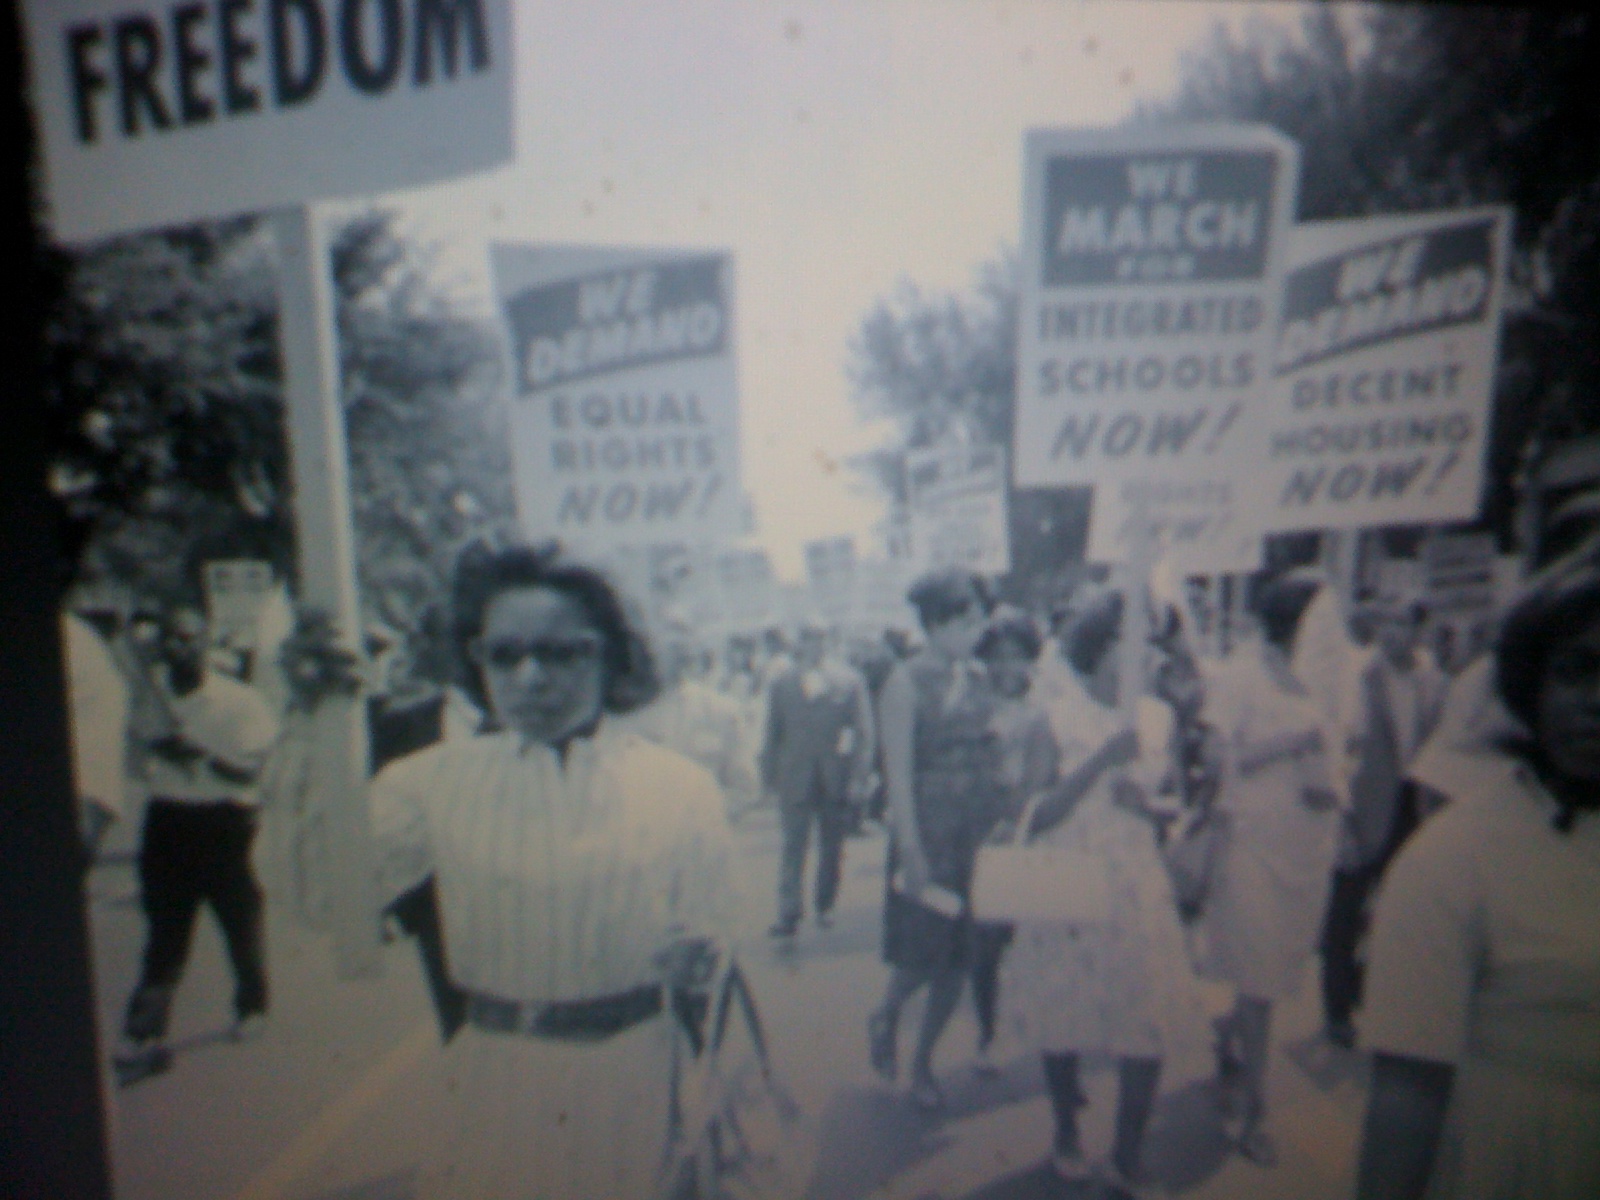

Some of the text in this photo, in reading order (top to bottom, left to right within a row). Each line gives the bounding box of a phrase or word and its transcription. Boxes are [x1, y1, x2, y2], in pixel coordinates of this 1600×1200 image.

[65, 0, 490, 146] FREEDOM
[1126, 158, 1197, 199] WE
[1055, 200, 1261, 253] MARCH
[1338, 234, 1428, 301] WE
[577, 268, 658, 323] WE
[1037, 296, 1264, 342] INTEGRATED
[1277, 264, 1489, 361] DEMAND
[525, 300, 723, 383] DEMAND
[1037, 353, 1256, 397] SCHOOLS
[1291, 361, 1466, 412] DECENT
[552, 392, 706, 430] EQUAL
[1050, 399, 1244, 462] NOW!
[1268, 410, 1473, 457] HOUSING
[551, 436, 718, 471] RIGHTS
[1276, 449, 1461, 509] NOW!
[556, 472, 724, 525] NOW!
